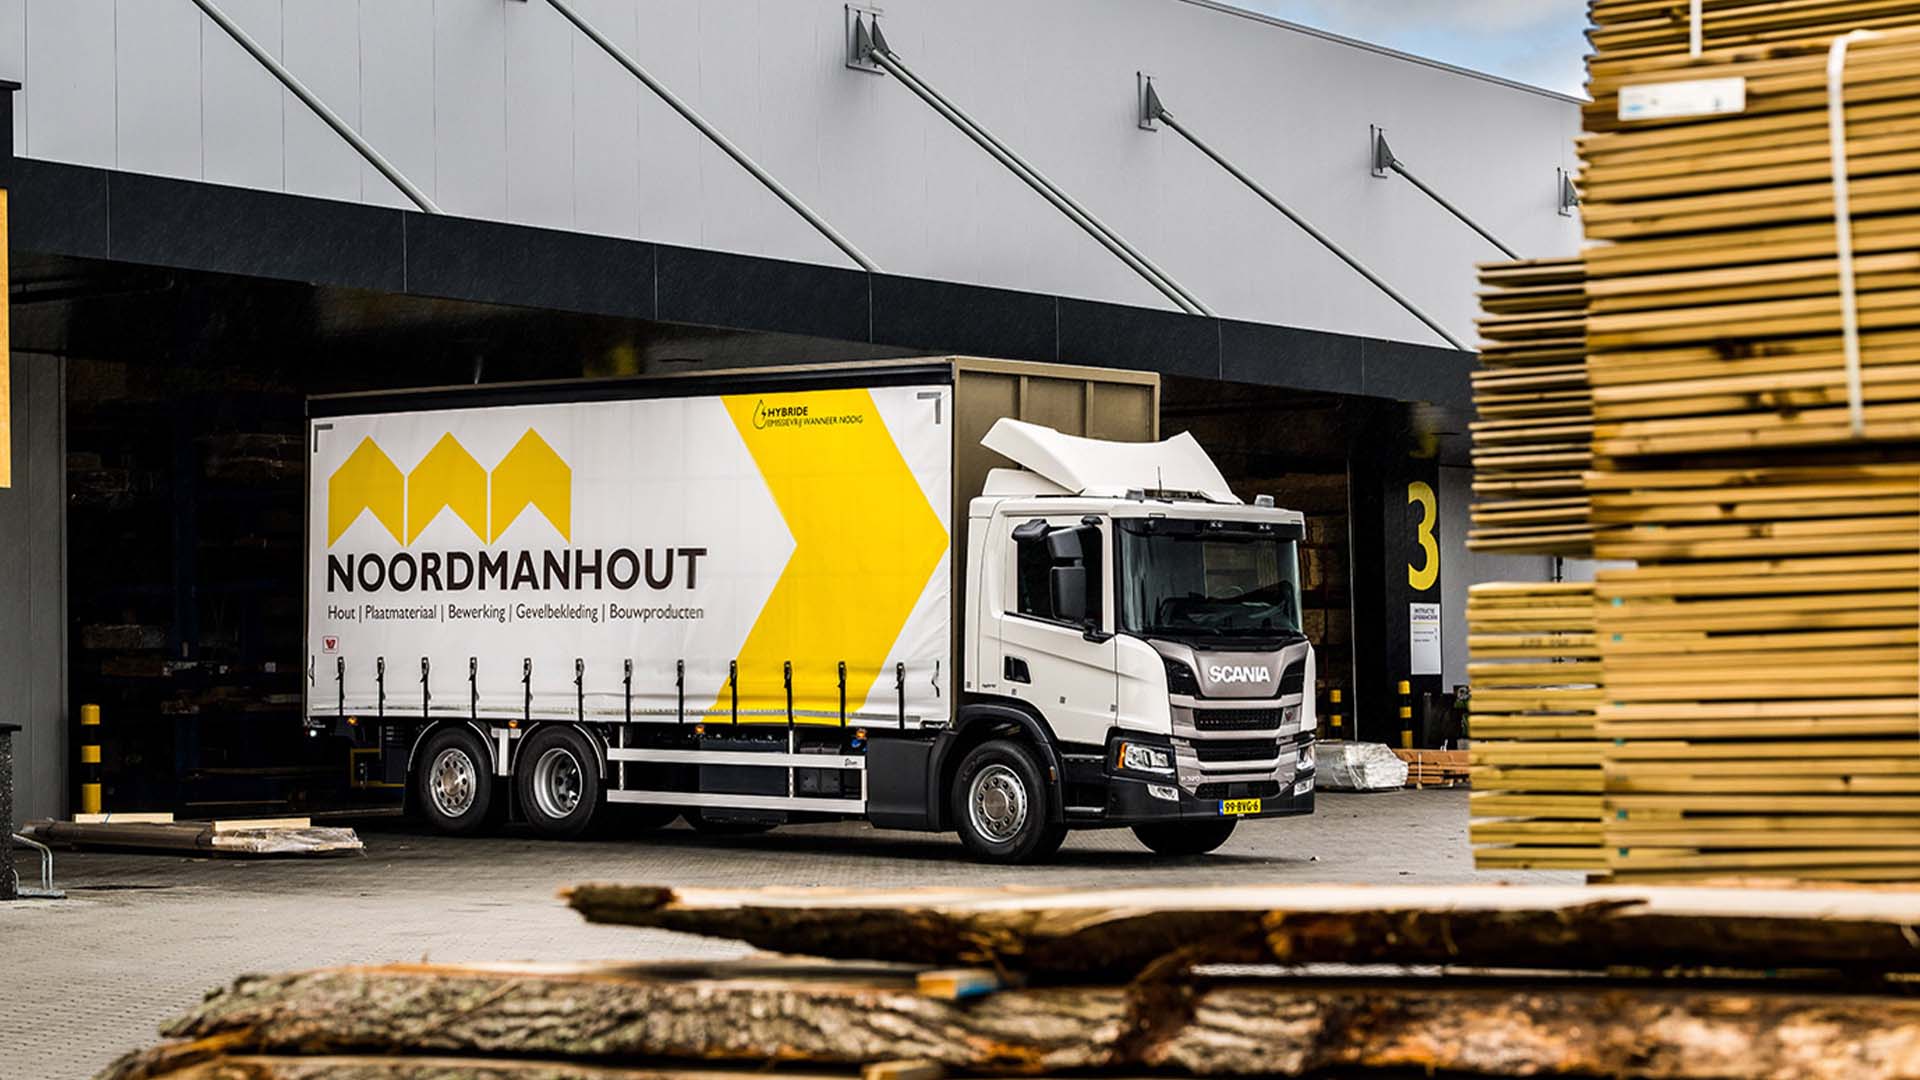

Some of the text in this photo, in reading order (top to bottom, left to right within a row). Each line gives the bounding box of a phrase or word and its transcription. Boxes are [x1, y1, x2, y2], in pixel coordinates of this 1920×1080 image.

[767, 406, 808, 417] HYBRIDE
[803, 416, 838, 426] WANNEER
[1408, 481, 1439, 590] 3
[327, 548, 707, 592] NOORDMANHOUT
[328, 605, 355, 619] Hout
[365, 604, 437, 619] Plaatmateriaal
[448, 604, 506, 623] Bewerking
[516, 603, 598, 623] Gevelbekleding
[610, 603, 704, 623] Bouwproducten
[1208, 666, 1270, 682] SCANIA
